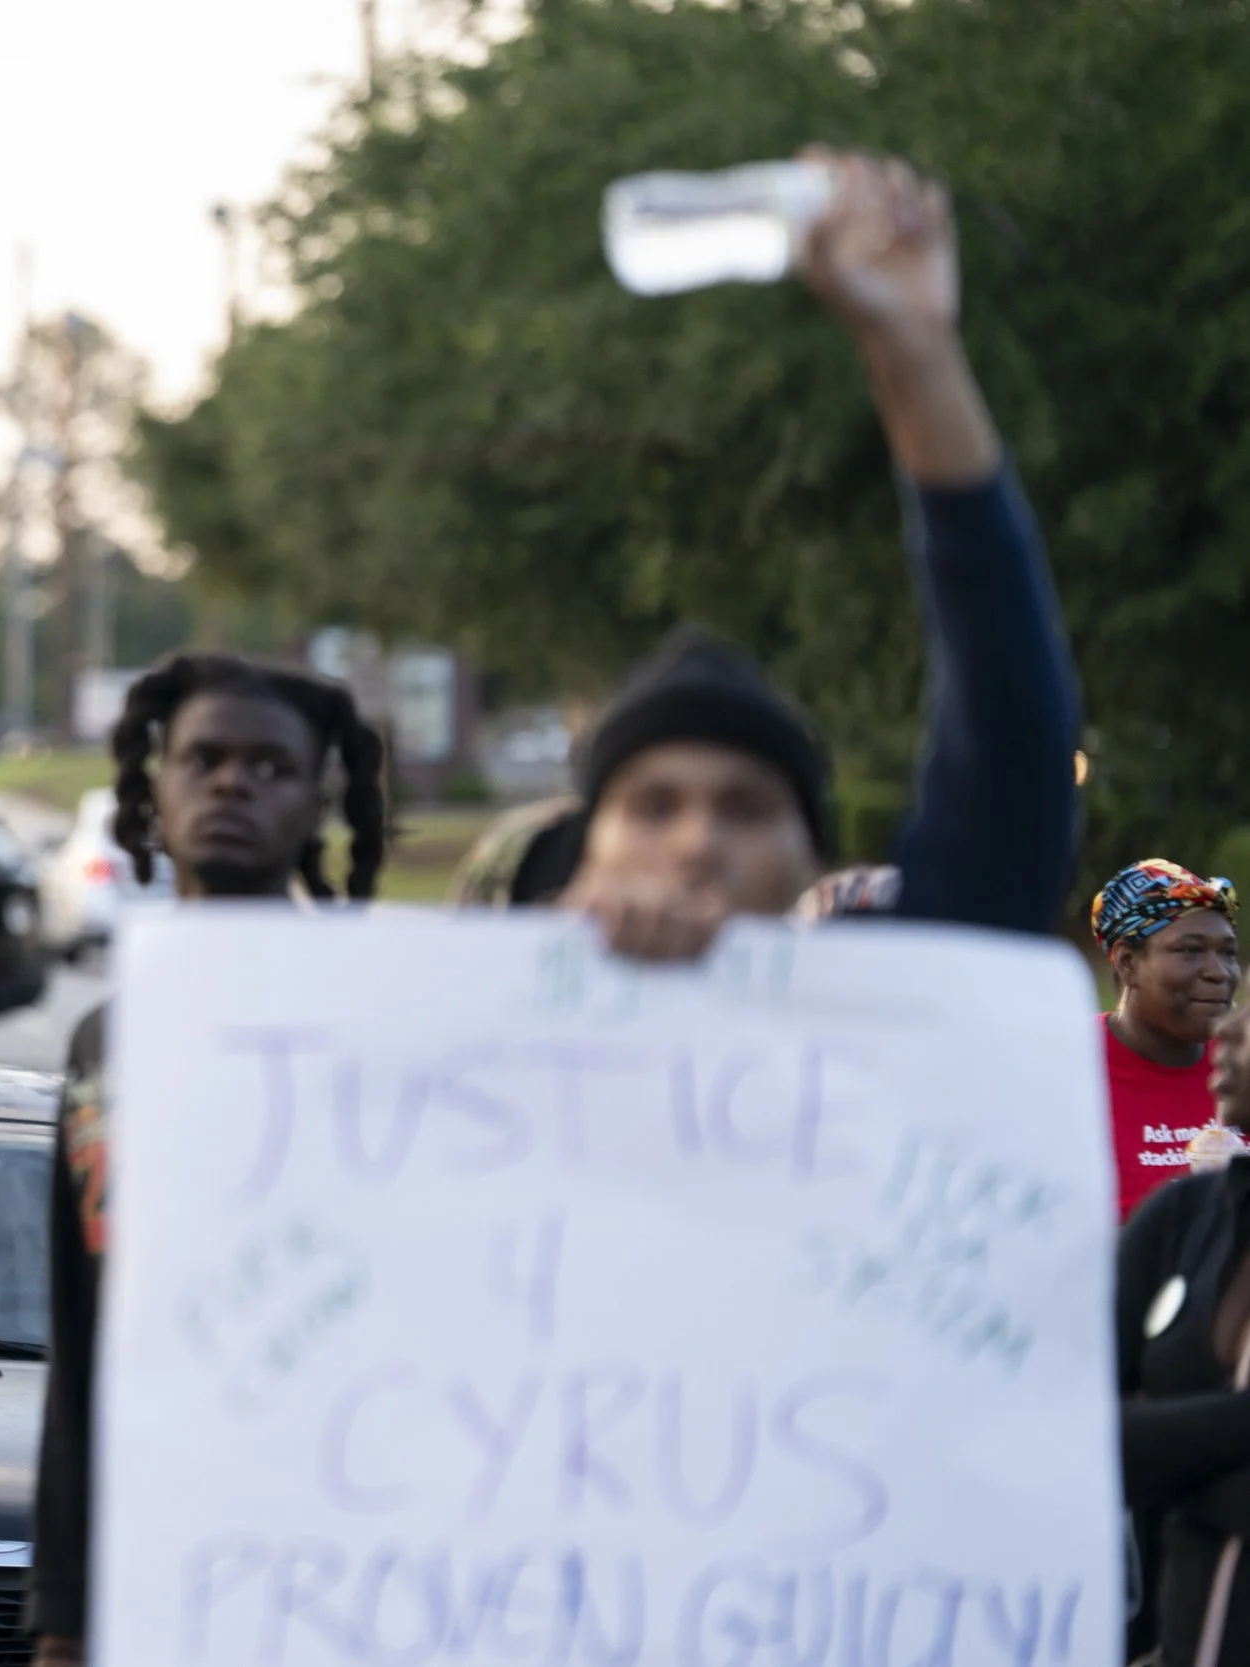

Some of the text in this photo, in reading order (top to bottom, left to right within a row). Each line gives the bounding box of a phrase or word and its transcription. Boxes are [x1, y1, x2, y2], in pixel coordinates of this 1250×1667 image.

[218, 1022, 878, 1204] JUSTICE
[1143, 1123, 1175, 1143] Ask
[1174, 1126, 1201, 1142] me
[483, 1204, 570, 1350] 4
[315, 1358, 893, 1556] CYRUS
